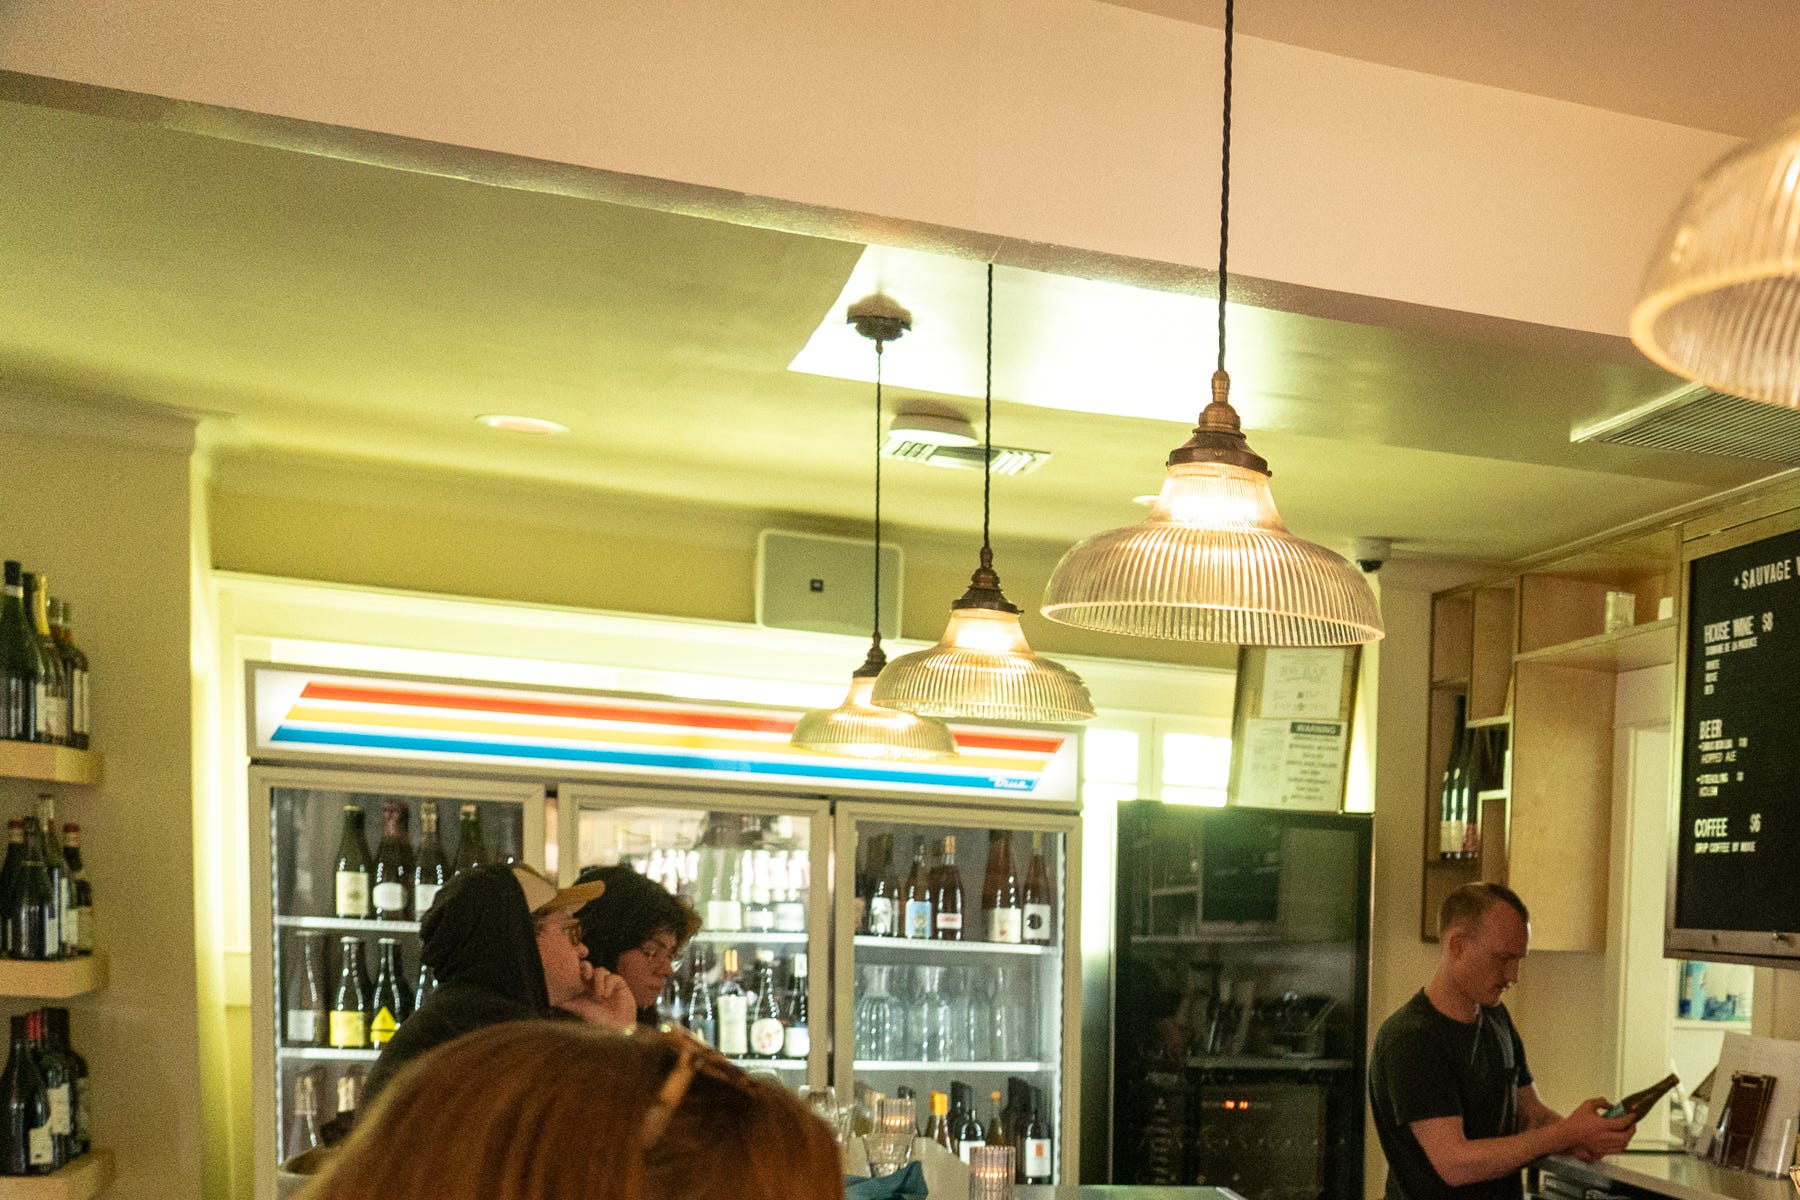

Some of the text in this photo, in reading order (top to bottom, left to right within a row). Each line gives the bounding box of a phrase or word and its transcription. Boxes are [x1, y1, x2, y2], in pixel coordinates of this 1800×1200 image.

[1741, 559, 1792, 590] SAUVAGE
[1703, 620, 1731, 644] HOUSE
[1699, 719, 1723, 740] BEER
[1694, 817, 1728, 838] COFFEE
